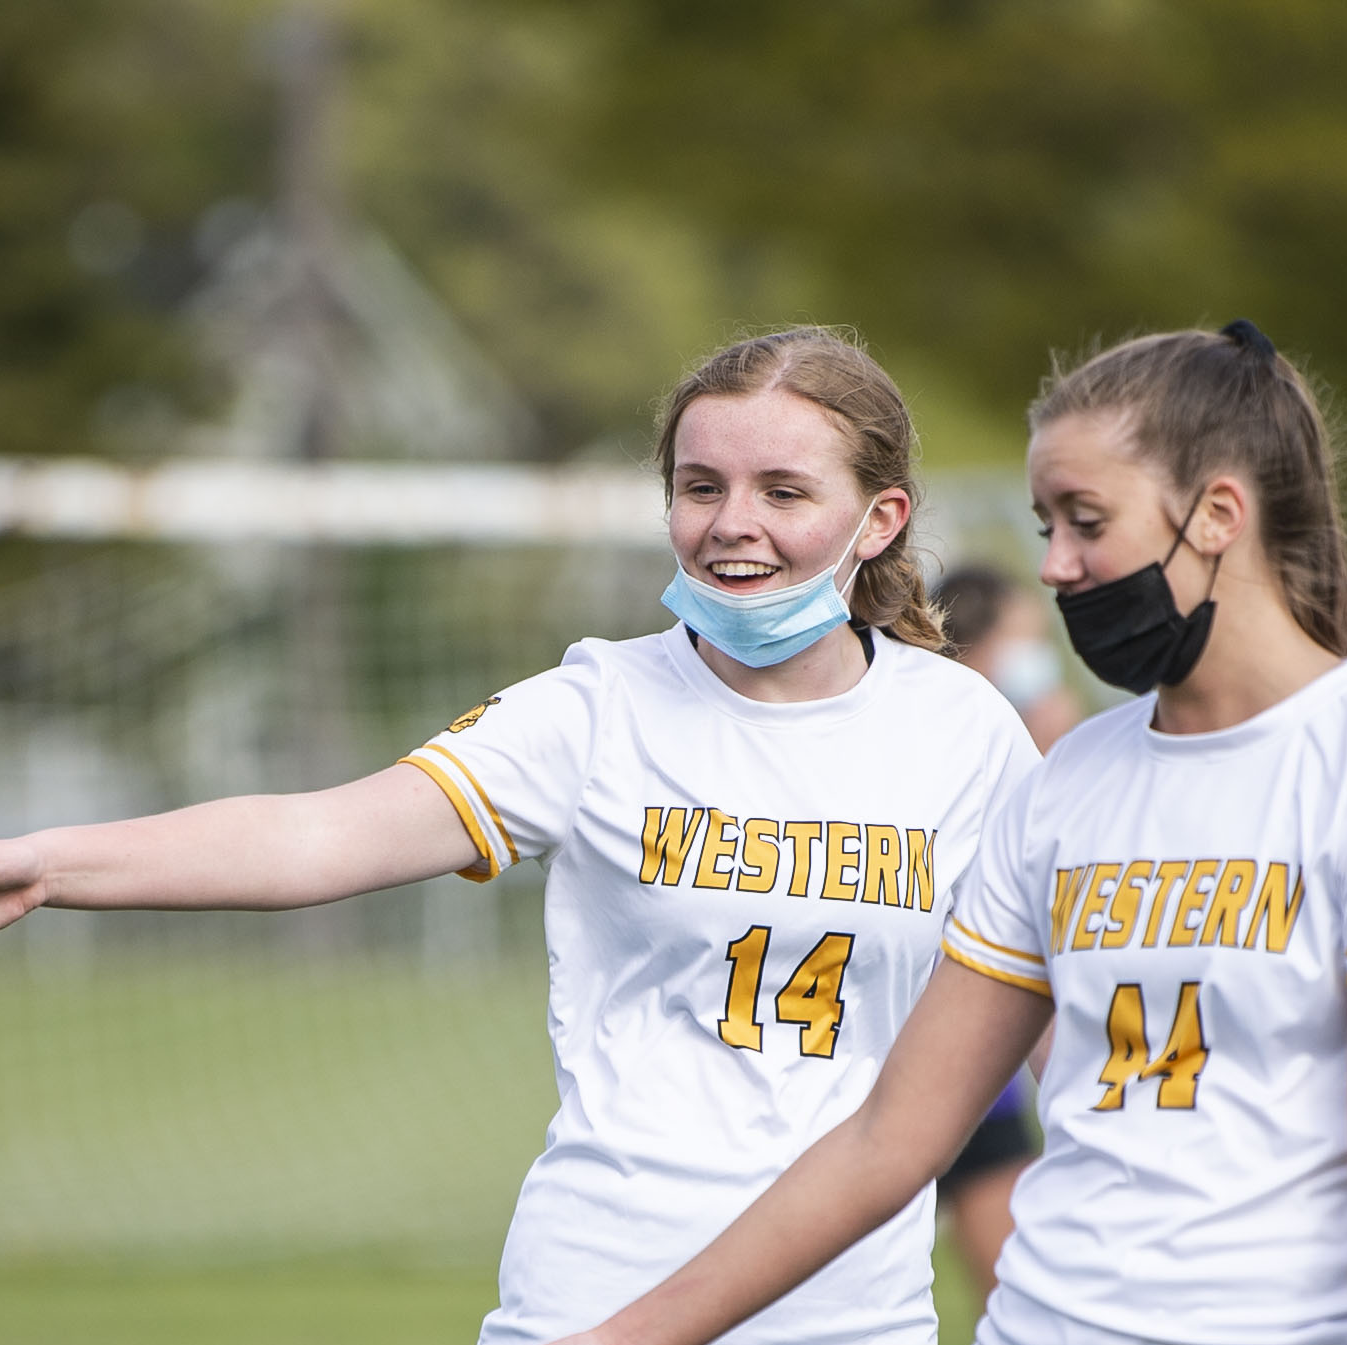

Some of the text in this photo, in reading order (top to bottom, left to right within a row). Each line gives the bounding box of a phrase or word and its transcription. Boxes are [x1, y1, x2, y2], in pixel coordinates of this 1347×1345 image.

[639, 807, 938, 912] WESTERN
[1050, 859, 1306, 956] WESTERN
[717, 924, 856, 1059] 14
[1089, 980, 1211, 1112] 44
